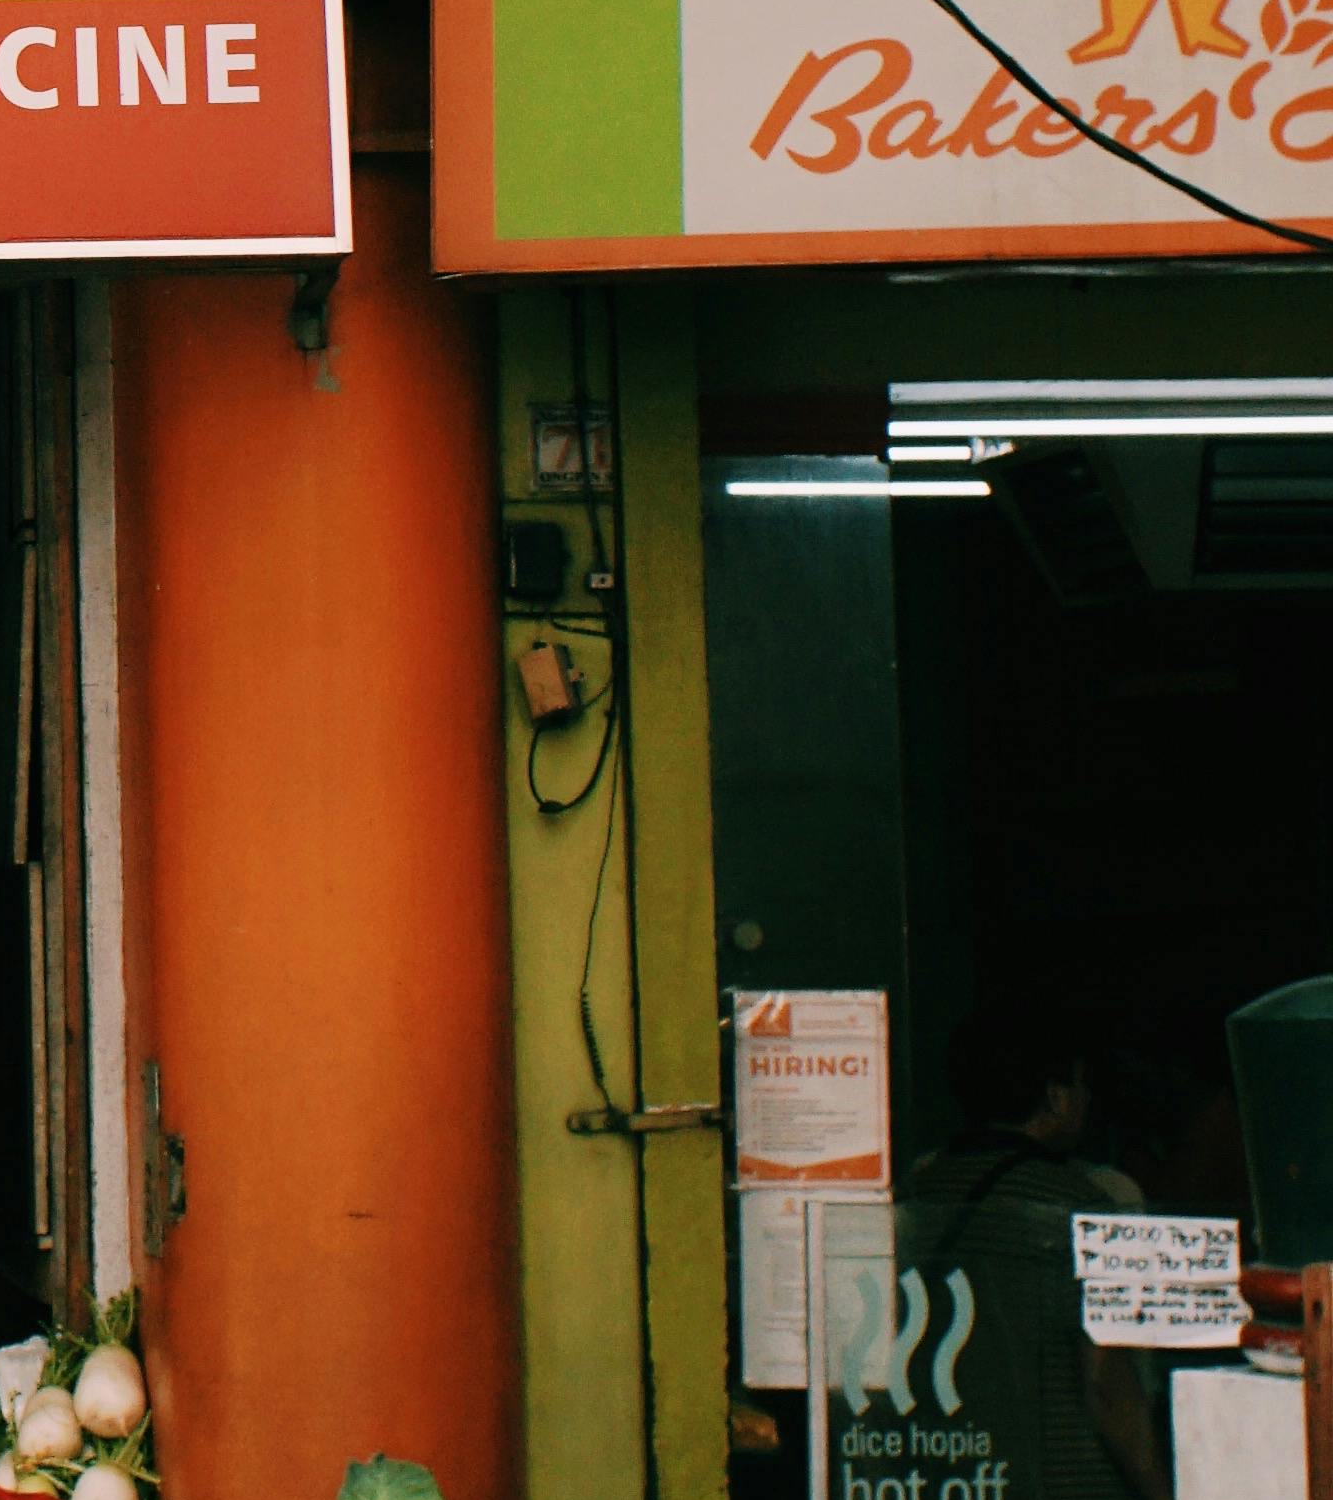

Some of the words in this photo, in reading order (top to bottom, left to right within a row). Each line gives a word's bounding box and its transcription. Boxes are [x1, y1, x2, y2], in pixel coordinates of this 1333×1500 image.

[747, 1054, 869, 1077] HIRING!
[841, 1421, 903, 1458] dice
[909, 1420, 992, 1465] hopia
